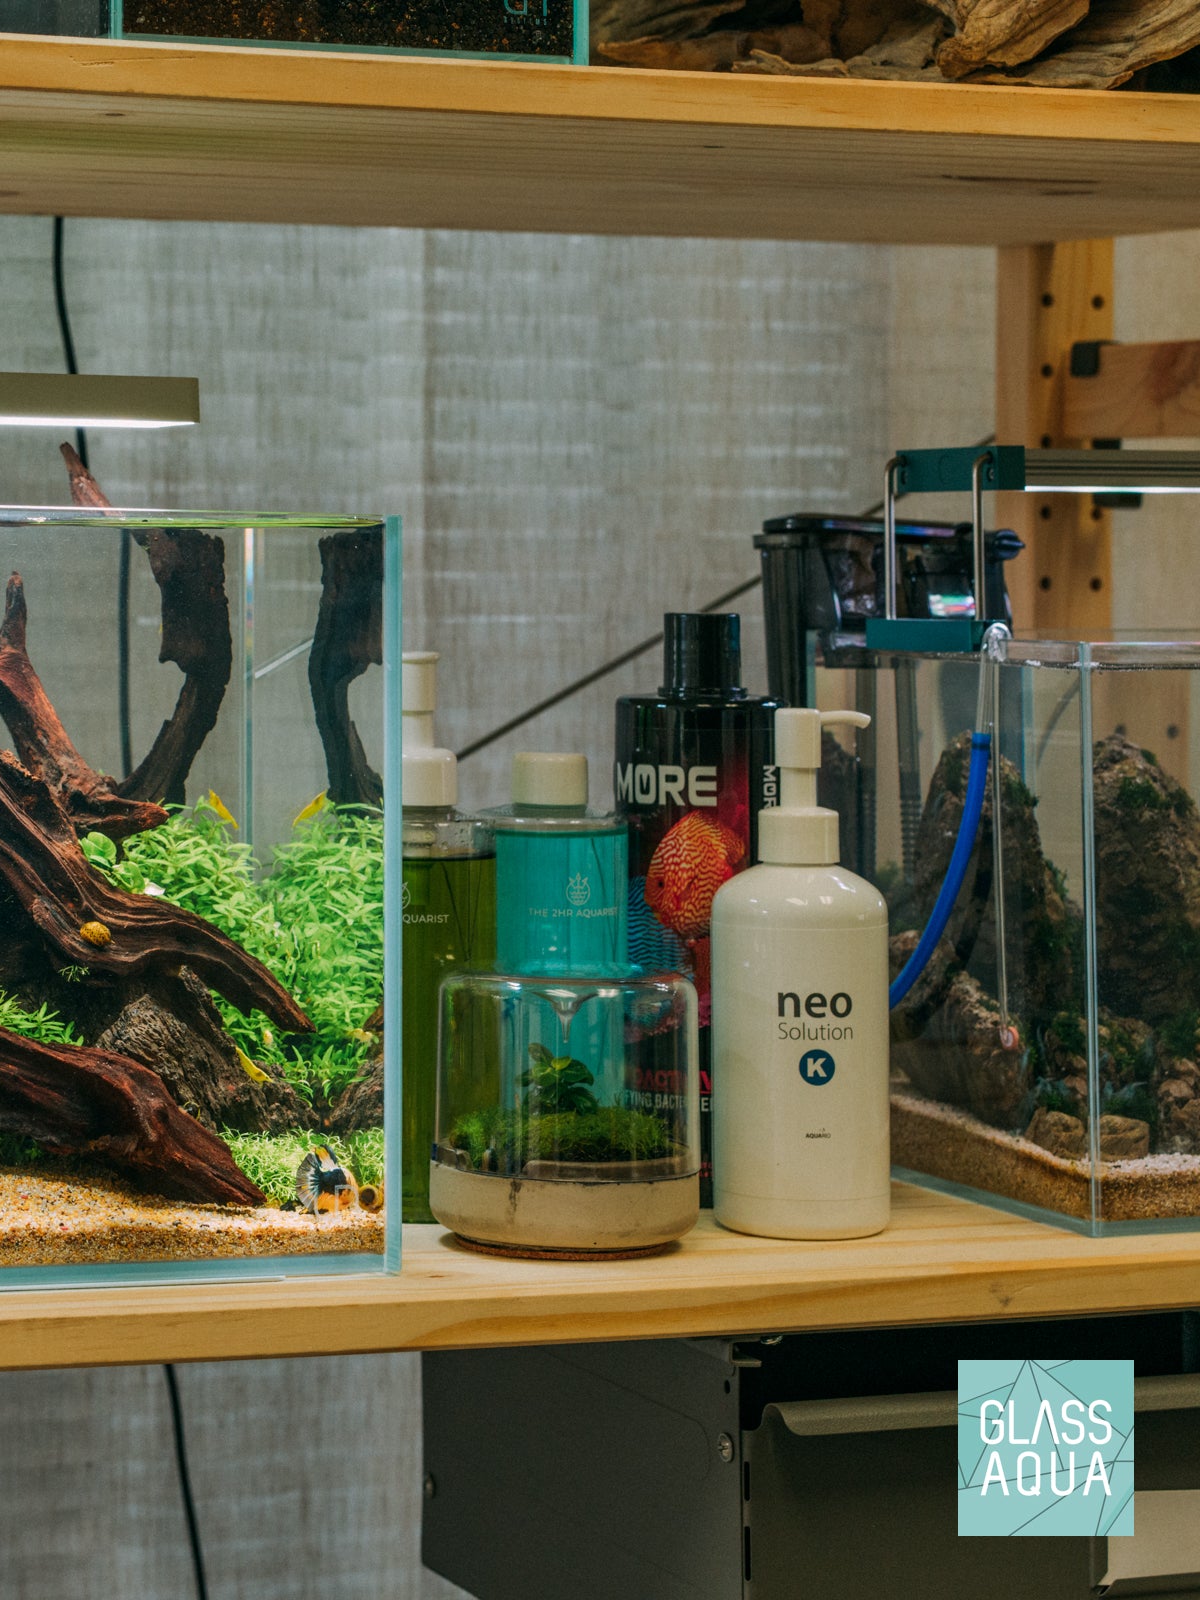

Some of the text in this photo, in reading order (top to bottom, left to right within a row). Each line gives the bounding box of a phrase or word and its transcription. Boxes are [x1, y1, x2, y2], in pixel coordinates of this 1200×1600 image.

[616, 762, 717, 807] MORE
[762, 765, 777, 809] MOR
[402, 913, 450, 924] QUARIST
[528, 907, 618, 919] THE 2HR AQUARIST
[777, 992, 853, 1018] neo
[778, 1022, 853, 1041] Solution
[806, 1058, 827, 1078] K
